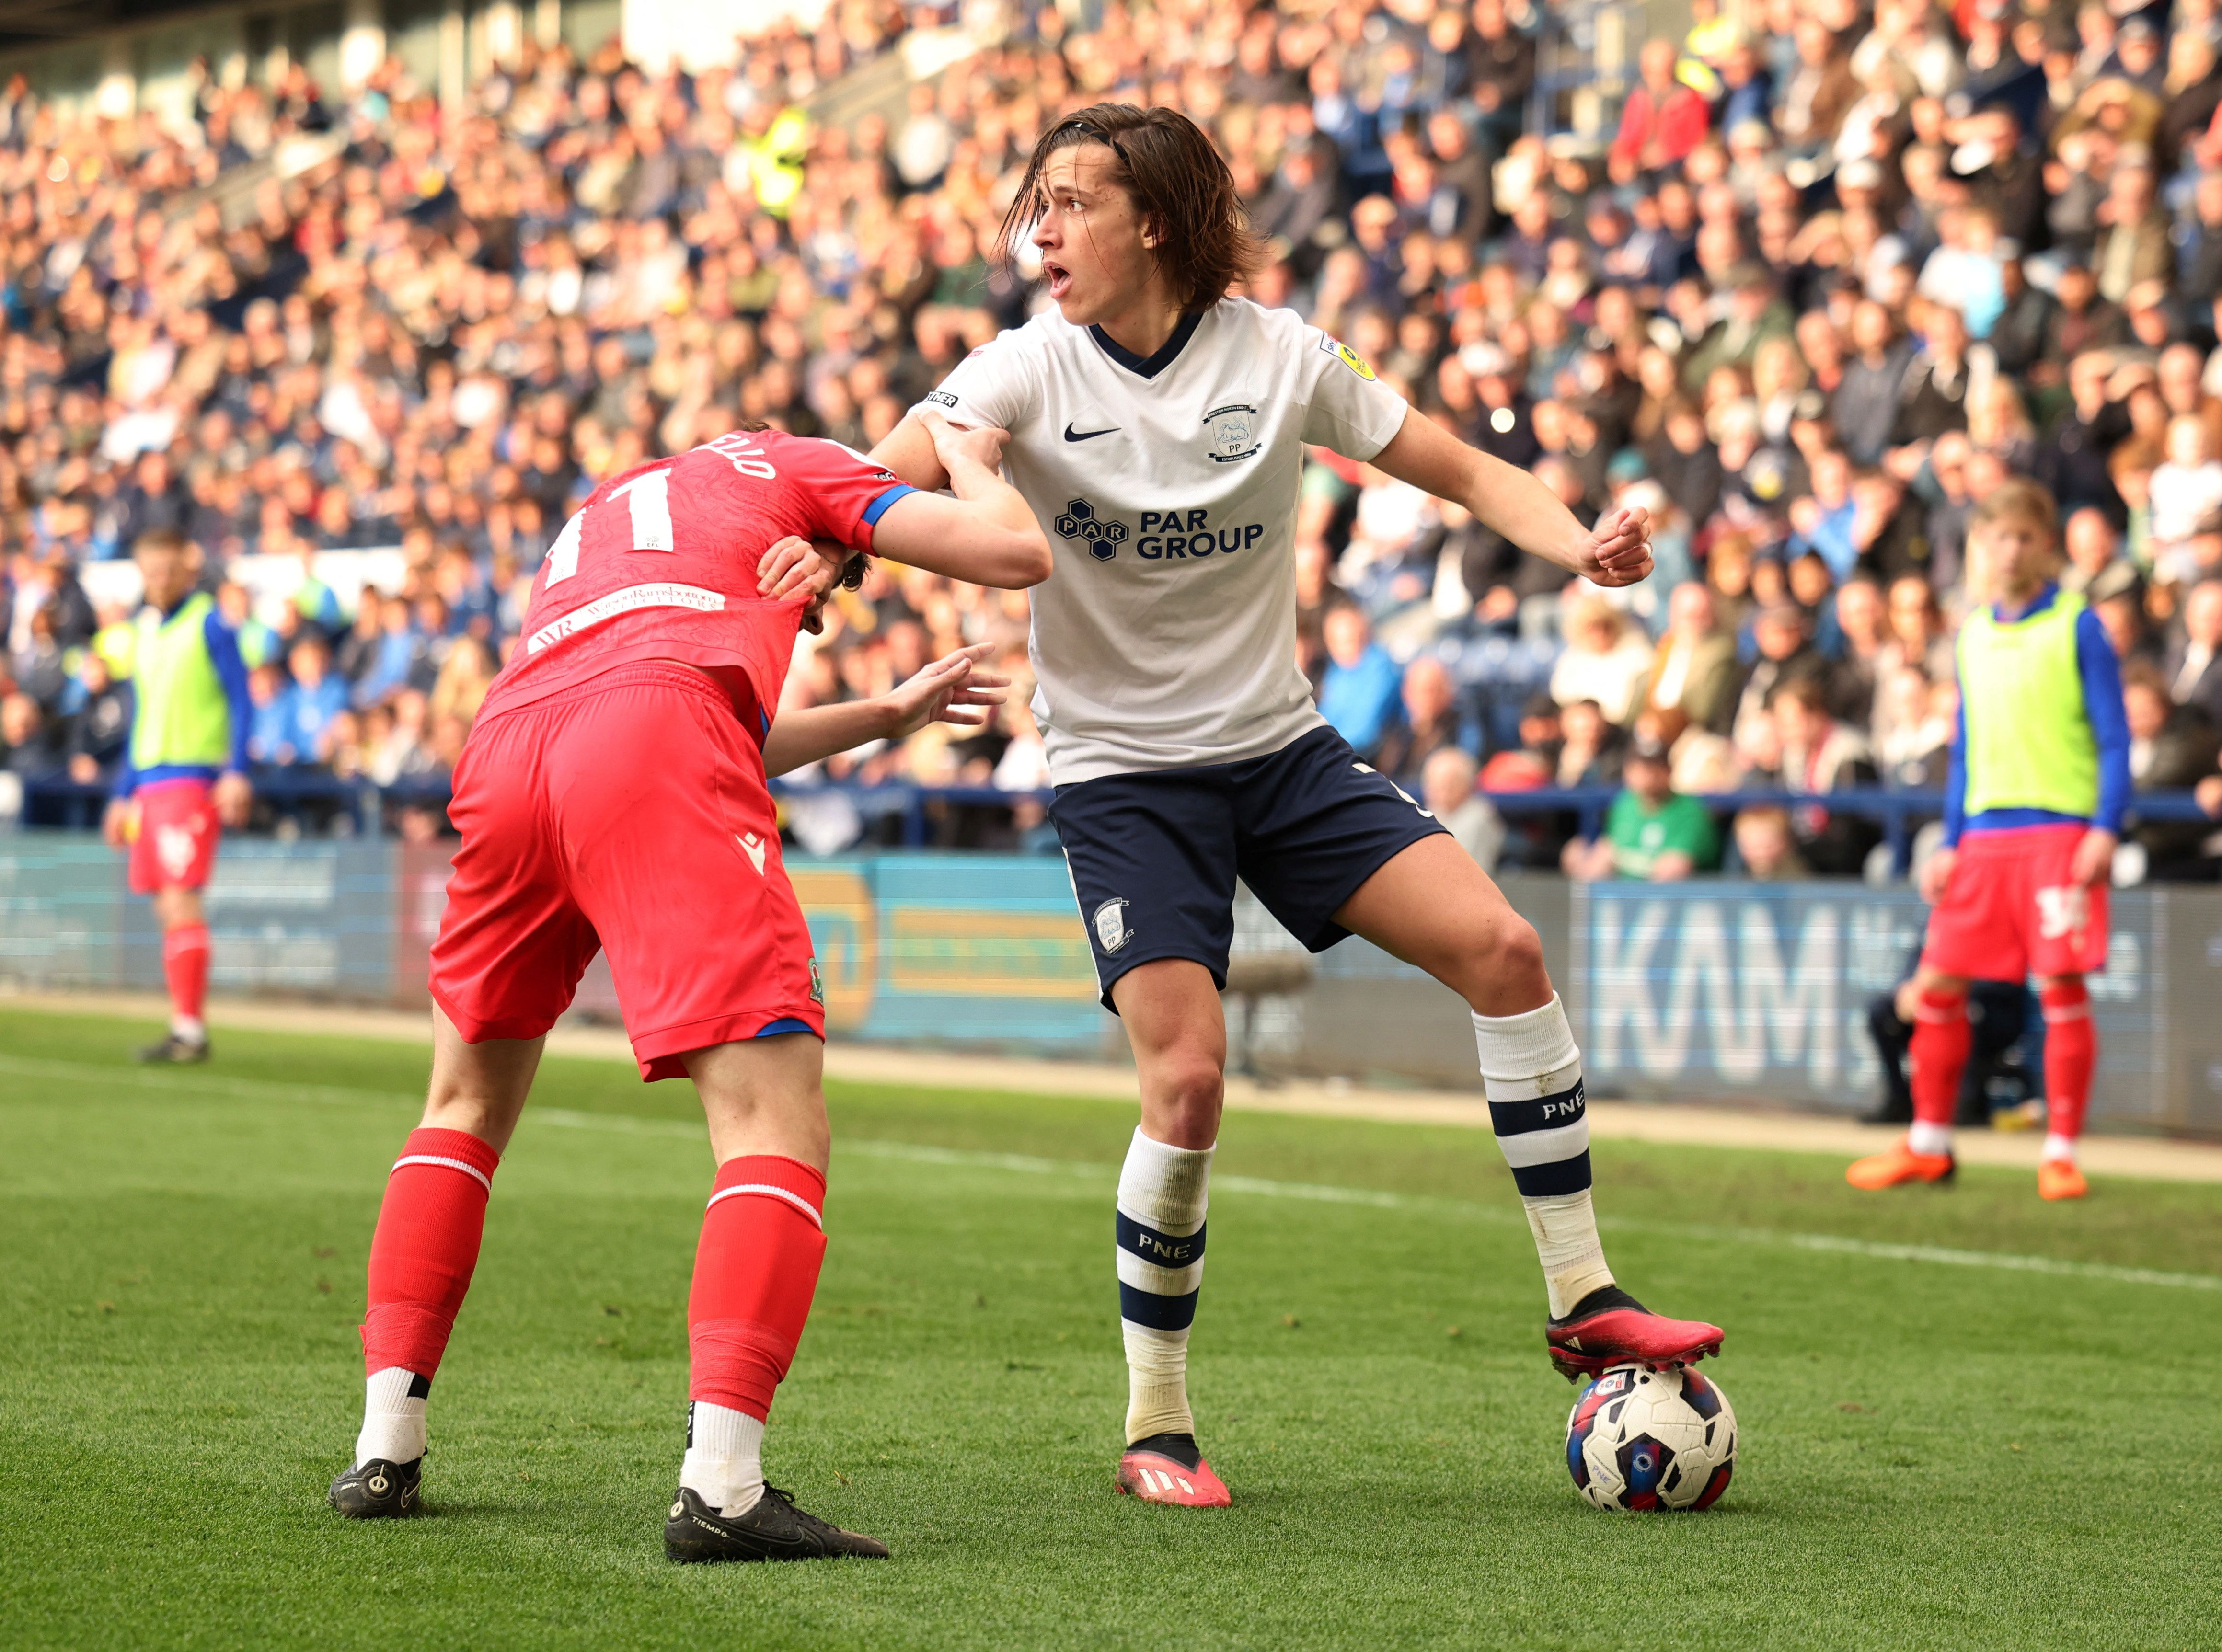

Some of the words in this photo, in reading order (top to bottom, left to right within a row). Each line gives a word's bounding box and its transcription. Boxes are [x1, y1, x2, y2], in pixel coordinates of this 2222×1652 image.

[1209, 409, 1224, 417] PRESTON
[695, 434, 776, 480] ELLO
[1229, 444, 1241, 453] PP
[1140, 509, 1208, 533] PAR
[1137, 524, 1264, 560] GROUP
[587, 587, 718, 617] WtsonRamsbottom
[536, 620, 574, 647] WR
[1108, 936, 1116, 947] PP
[1542, 1087, 1584, 1120] PNE
[1139, 1233, 1190, 1260] PNE
[1592, 1465, 1611, 1485] PNE
[692, 1516, 730, 1538] TIEMPO
